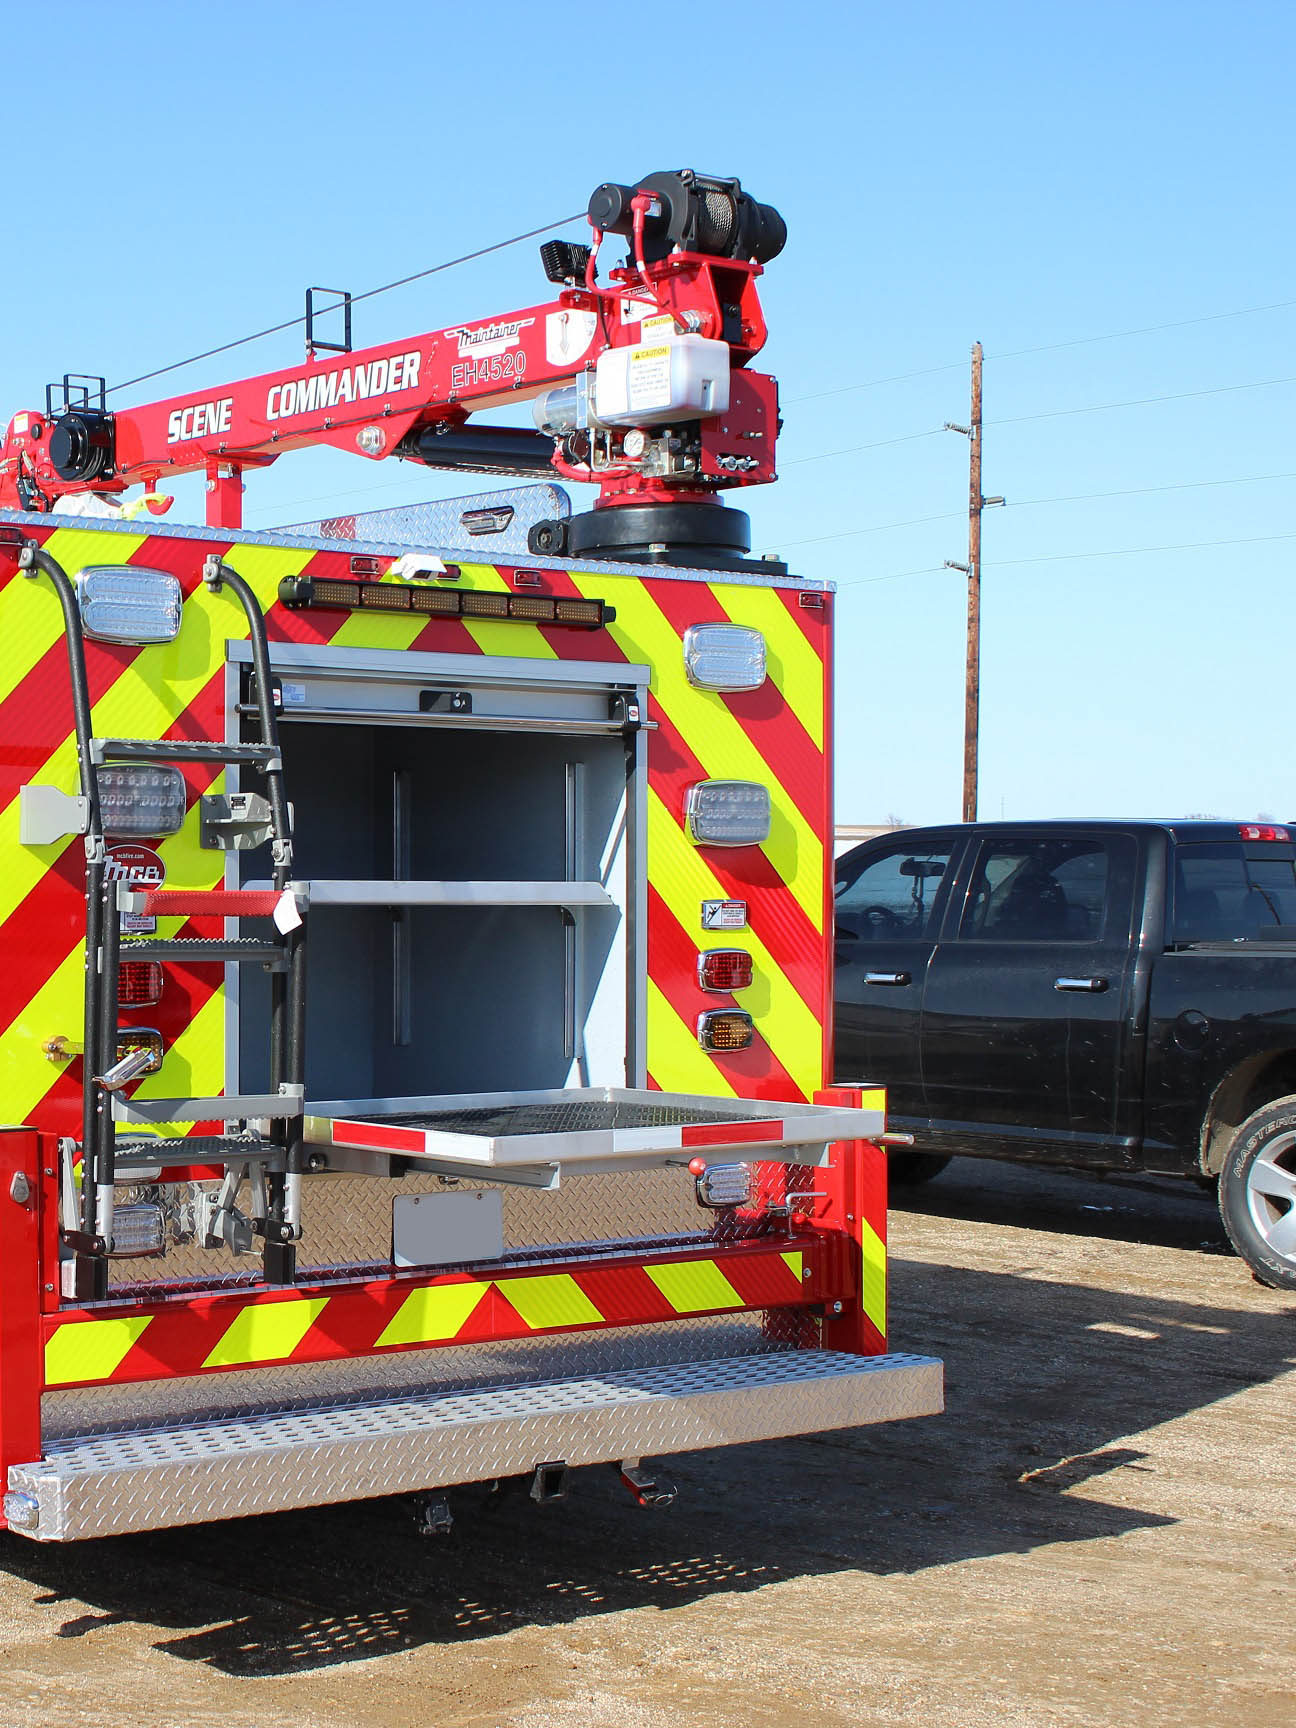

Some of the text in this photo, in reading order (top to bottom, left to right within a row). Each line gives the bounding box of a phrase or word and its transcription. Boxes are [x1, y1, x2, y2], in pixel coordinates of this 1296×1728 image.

[456, 321, 522, 348] Maintainer
[451, 350, 526, 389] EH4520
[641, 348, 667, 359] CAUTION
[167, 350, 421, 444] SCENE COMMANDER
